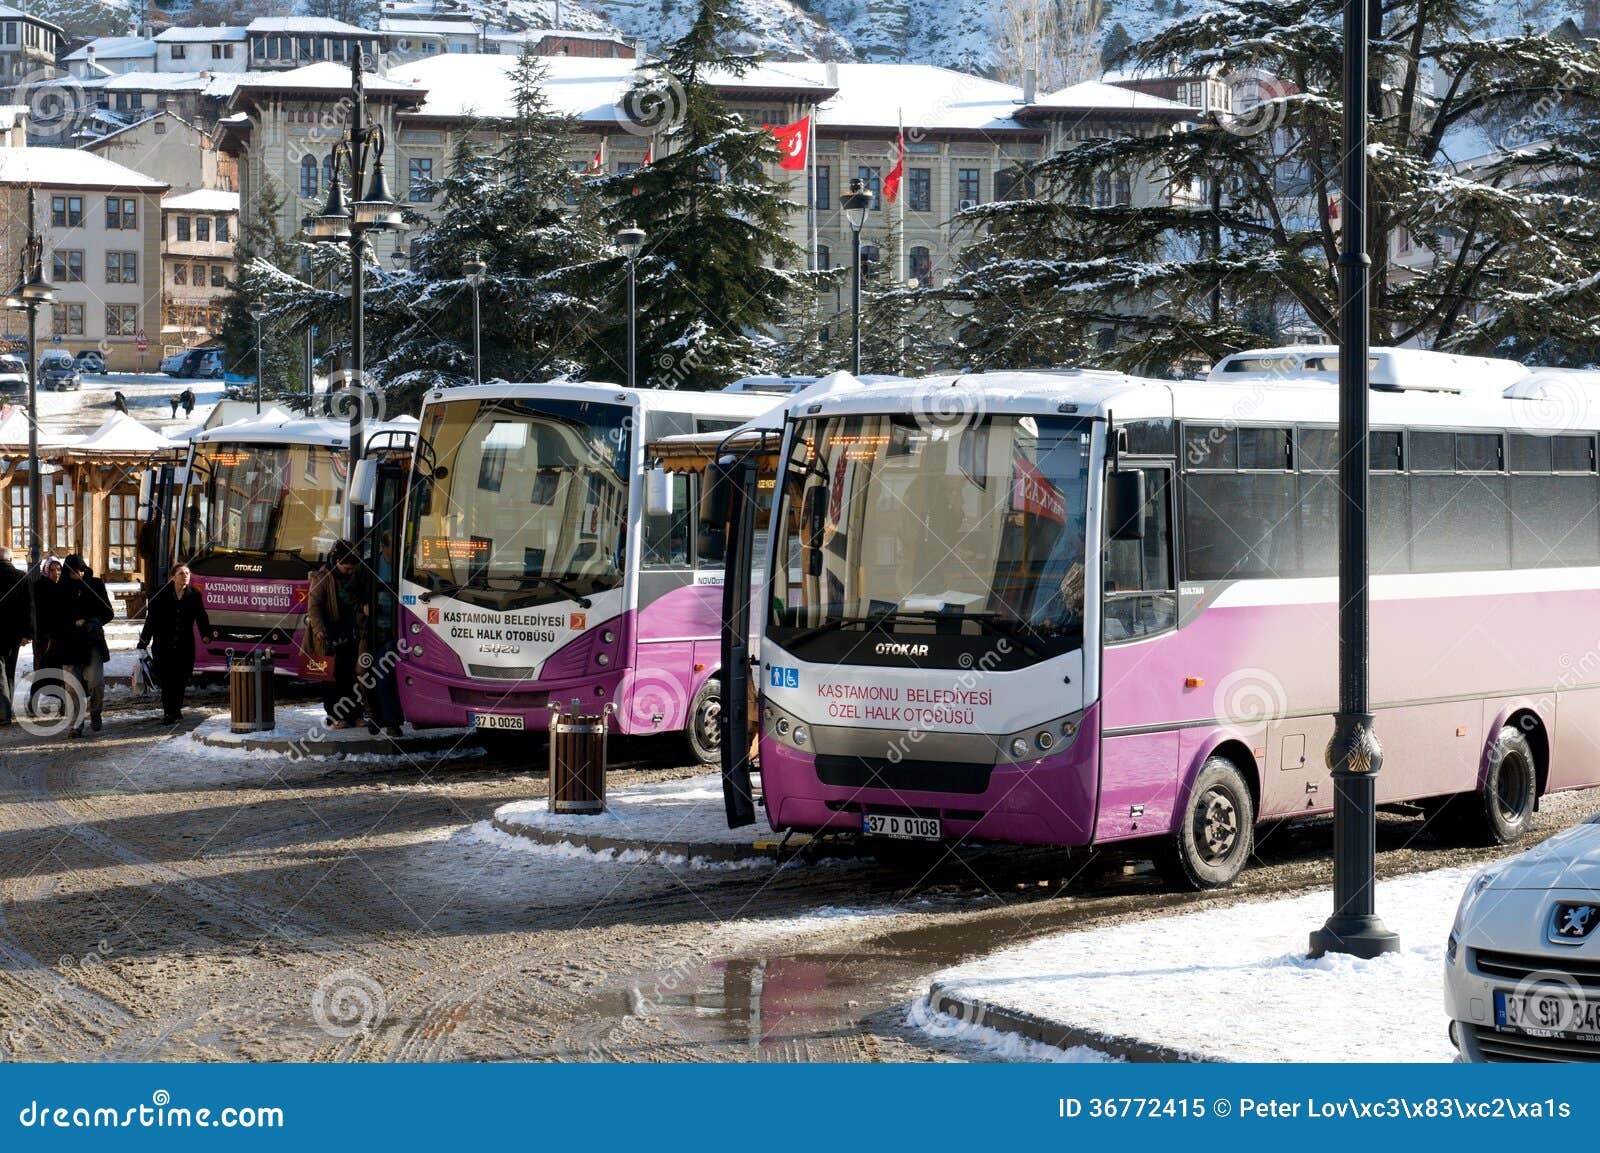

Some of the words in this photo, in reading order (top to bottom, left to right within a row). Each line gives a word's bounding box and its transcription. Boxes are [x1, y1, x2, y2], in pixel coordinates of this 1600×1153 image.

[234, 563, 263, 572] OTOKAR
[205, 582, 249, 593] KASTAMONU
[207, 592, 226, 604] ÖZEL
[228, 595, 249, 605] HALK
[251, 596, 290, 607] OTOBÜSÜ
[443, 611, 501, 625] KASTAMONU
[504, 613, 565, 627] BELEDİYESİ
[450, 626, 474, 639] ÖZEL
[477, 629, 503, 641] HALK
[505, 630, 555, 643] OTOBÜSÜ
[875, 643, 929, 657] OTOKAR
[818, 683, 899, 702] KASTAMONU
[907, 688, 993, 706] BELEDİYESİ
[828, 701, 861, 719] ÖZEL
[865, 706, 901, 722] HALK
[903, 707, 975, 726] OTOBÜSÜ
[475, 715, 487, 727] 37
[490, 716, 496, 727] D
[498, 717, 522, 729] 0026
[869, 816, 886, 832] 37
[890, 818, 899, 833] D
[904, 819, 938, 836] 0108
[1508, 997, 1527, 1023] 37
[1526, 1028, 1552, 1038] DELTA
